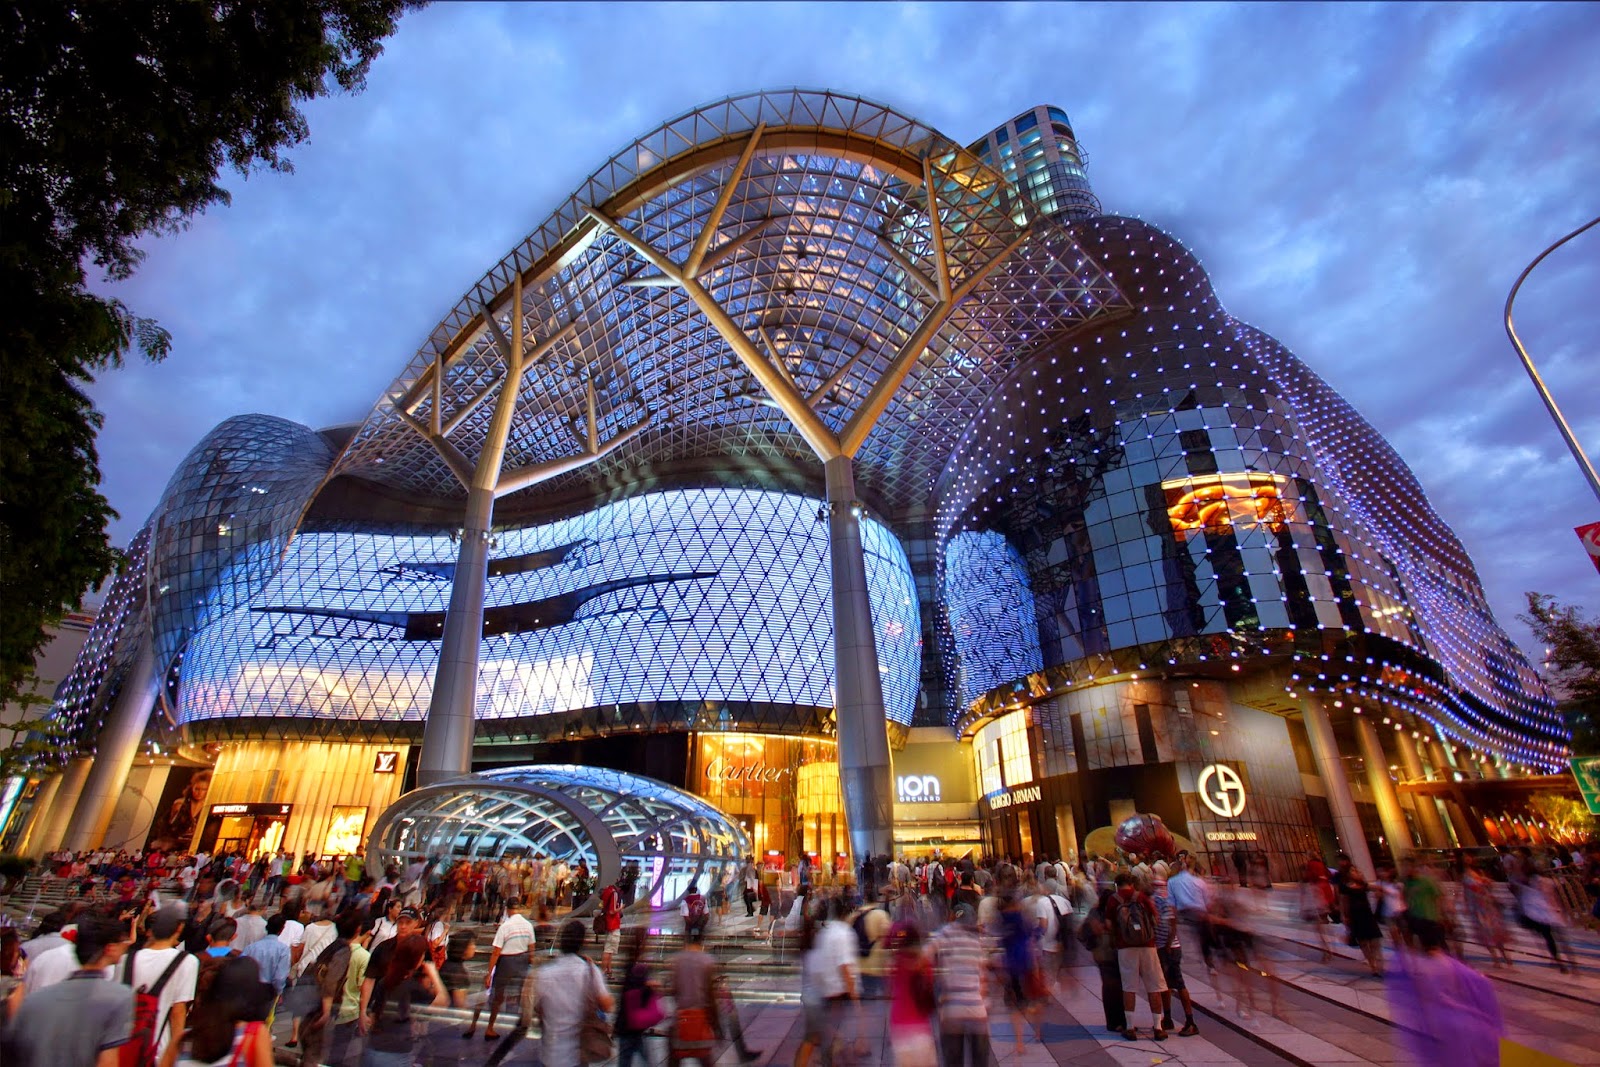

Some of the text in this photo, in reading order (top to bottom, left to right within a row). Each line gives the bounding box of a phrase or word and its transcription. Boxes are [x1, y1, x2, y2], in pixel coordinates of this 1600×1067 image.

[705, 756, 789, 782] Cartier
[990, 786, 1042, 810] GIORGIO ARMANI
[1207, 832, 1257, 841] GIORGIO ARMANI
